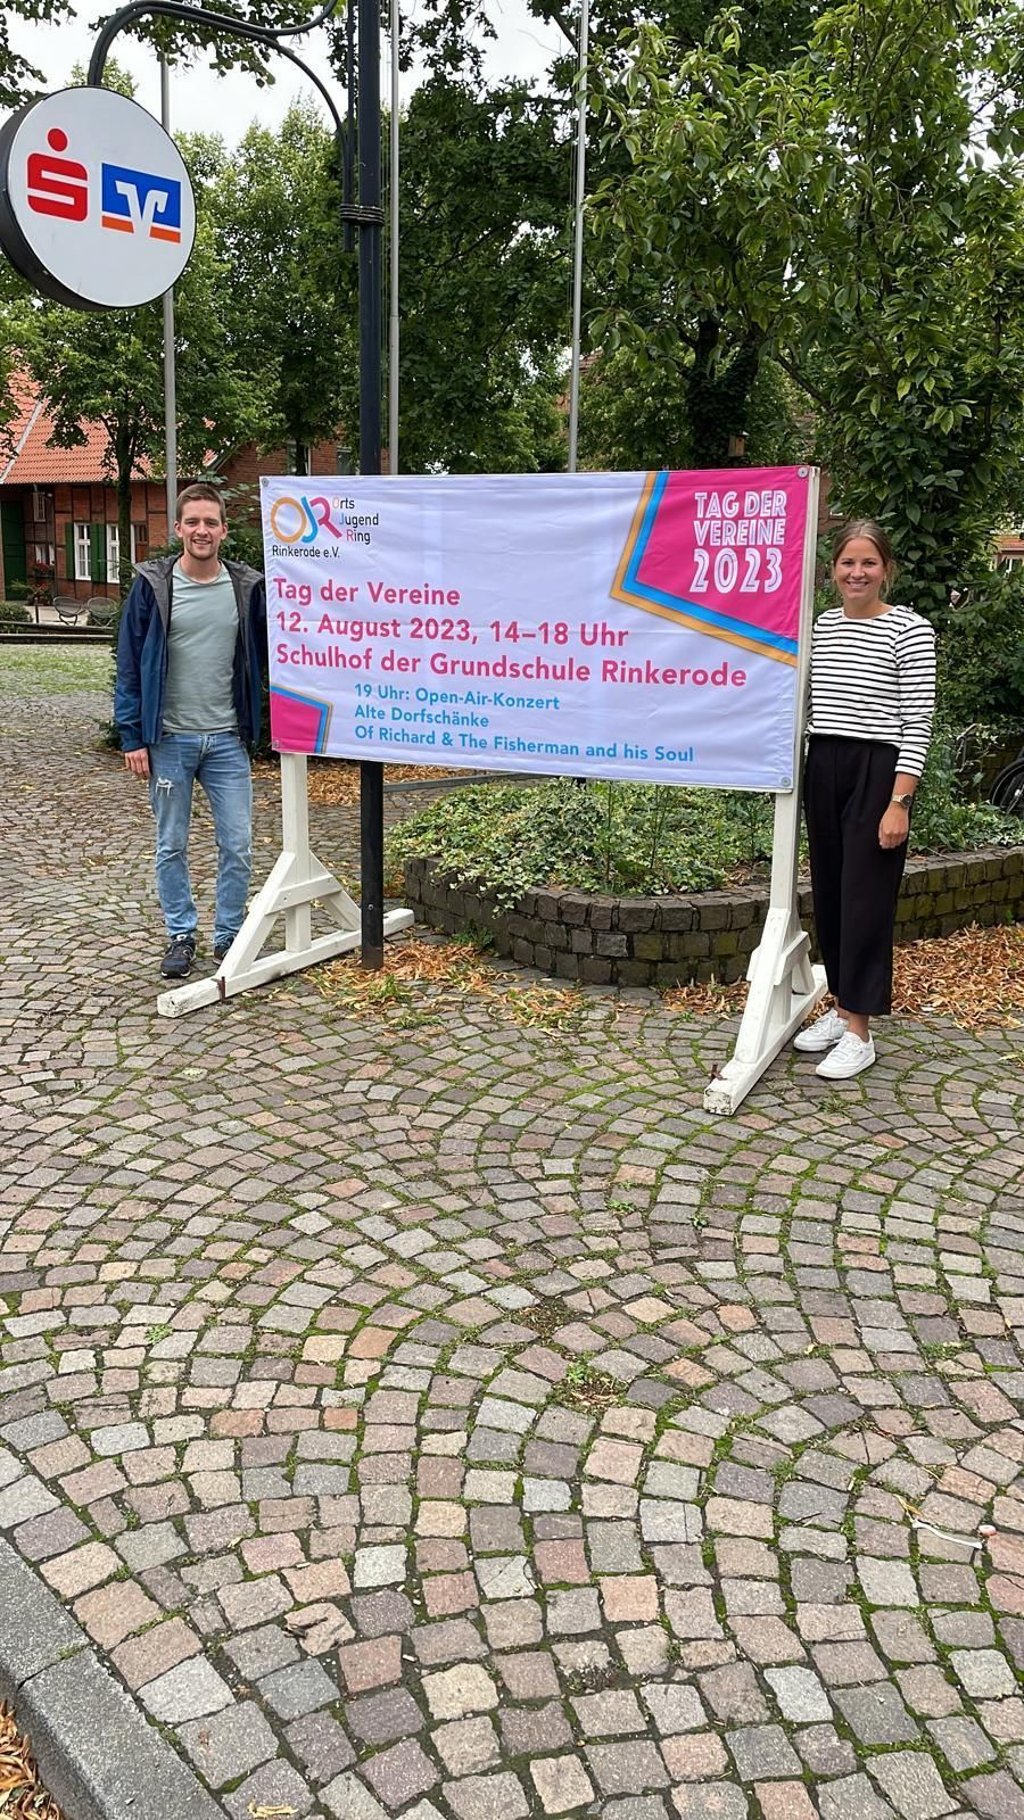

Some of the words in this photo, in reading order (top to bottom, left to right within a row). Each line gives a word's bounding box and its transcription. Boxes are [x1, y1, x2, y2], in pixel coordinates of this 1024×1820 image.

[332, 497, 355, 509] Orts
[694, 491, 740, 518] TAG
[743, 490, 787, 518] DER
[339, 514, 379, 528] Jugend
[693, 519, 786, 546] VEREINE
[346, 530, 371, 545] Ring
[272, 545, 320, 557] Rinkerode
[323, 547, 340, 558] e.V.
[689, 547, 783, 594] 2023
[273, 578, 312, 606] Tag
[320, 579, 359, 601] der
[367, 581, 461, 605] Vereine
[276, 611, 309, 633] 12.
[317, 613, 401, 642] August
[409, 618, 478, 645] 2023,
[579, 623, 629, 647] Uhr
[276, 643, 373, 670] Schulhof
[380, 649, 421, 672] der
[429, 652, 591, 682] Grundschule
[602, 660, 747, 687] Rinkerode
[354, 683, 373, 697] 19
[378, 685, 410, 701] Uhr:
[415, 687, 560, 710] Open-Air-Konzert
[354, 704, 386, 721] Alte
[391, 707, 490, 728] Dorfschänke
[355, 725, 375, 740] Of
[379, 727, 436, 746] Richard
[441, 732, 454, 747] &
[458, 733, 488, 749] The
[494, 736, 580, 756] Fisherman
[585, 743, 618, 758] and
[624, 744, 649, 760] his
[654, 746, 694, 762] Soul
